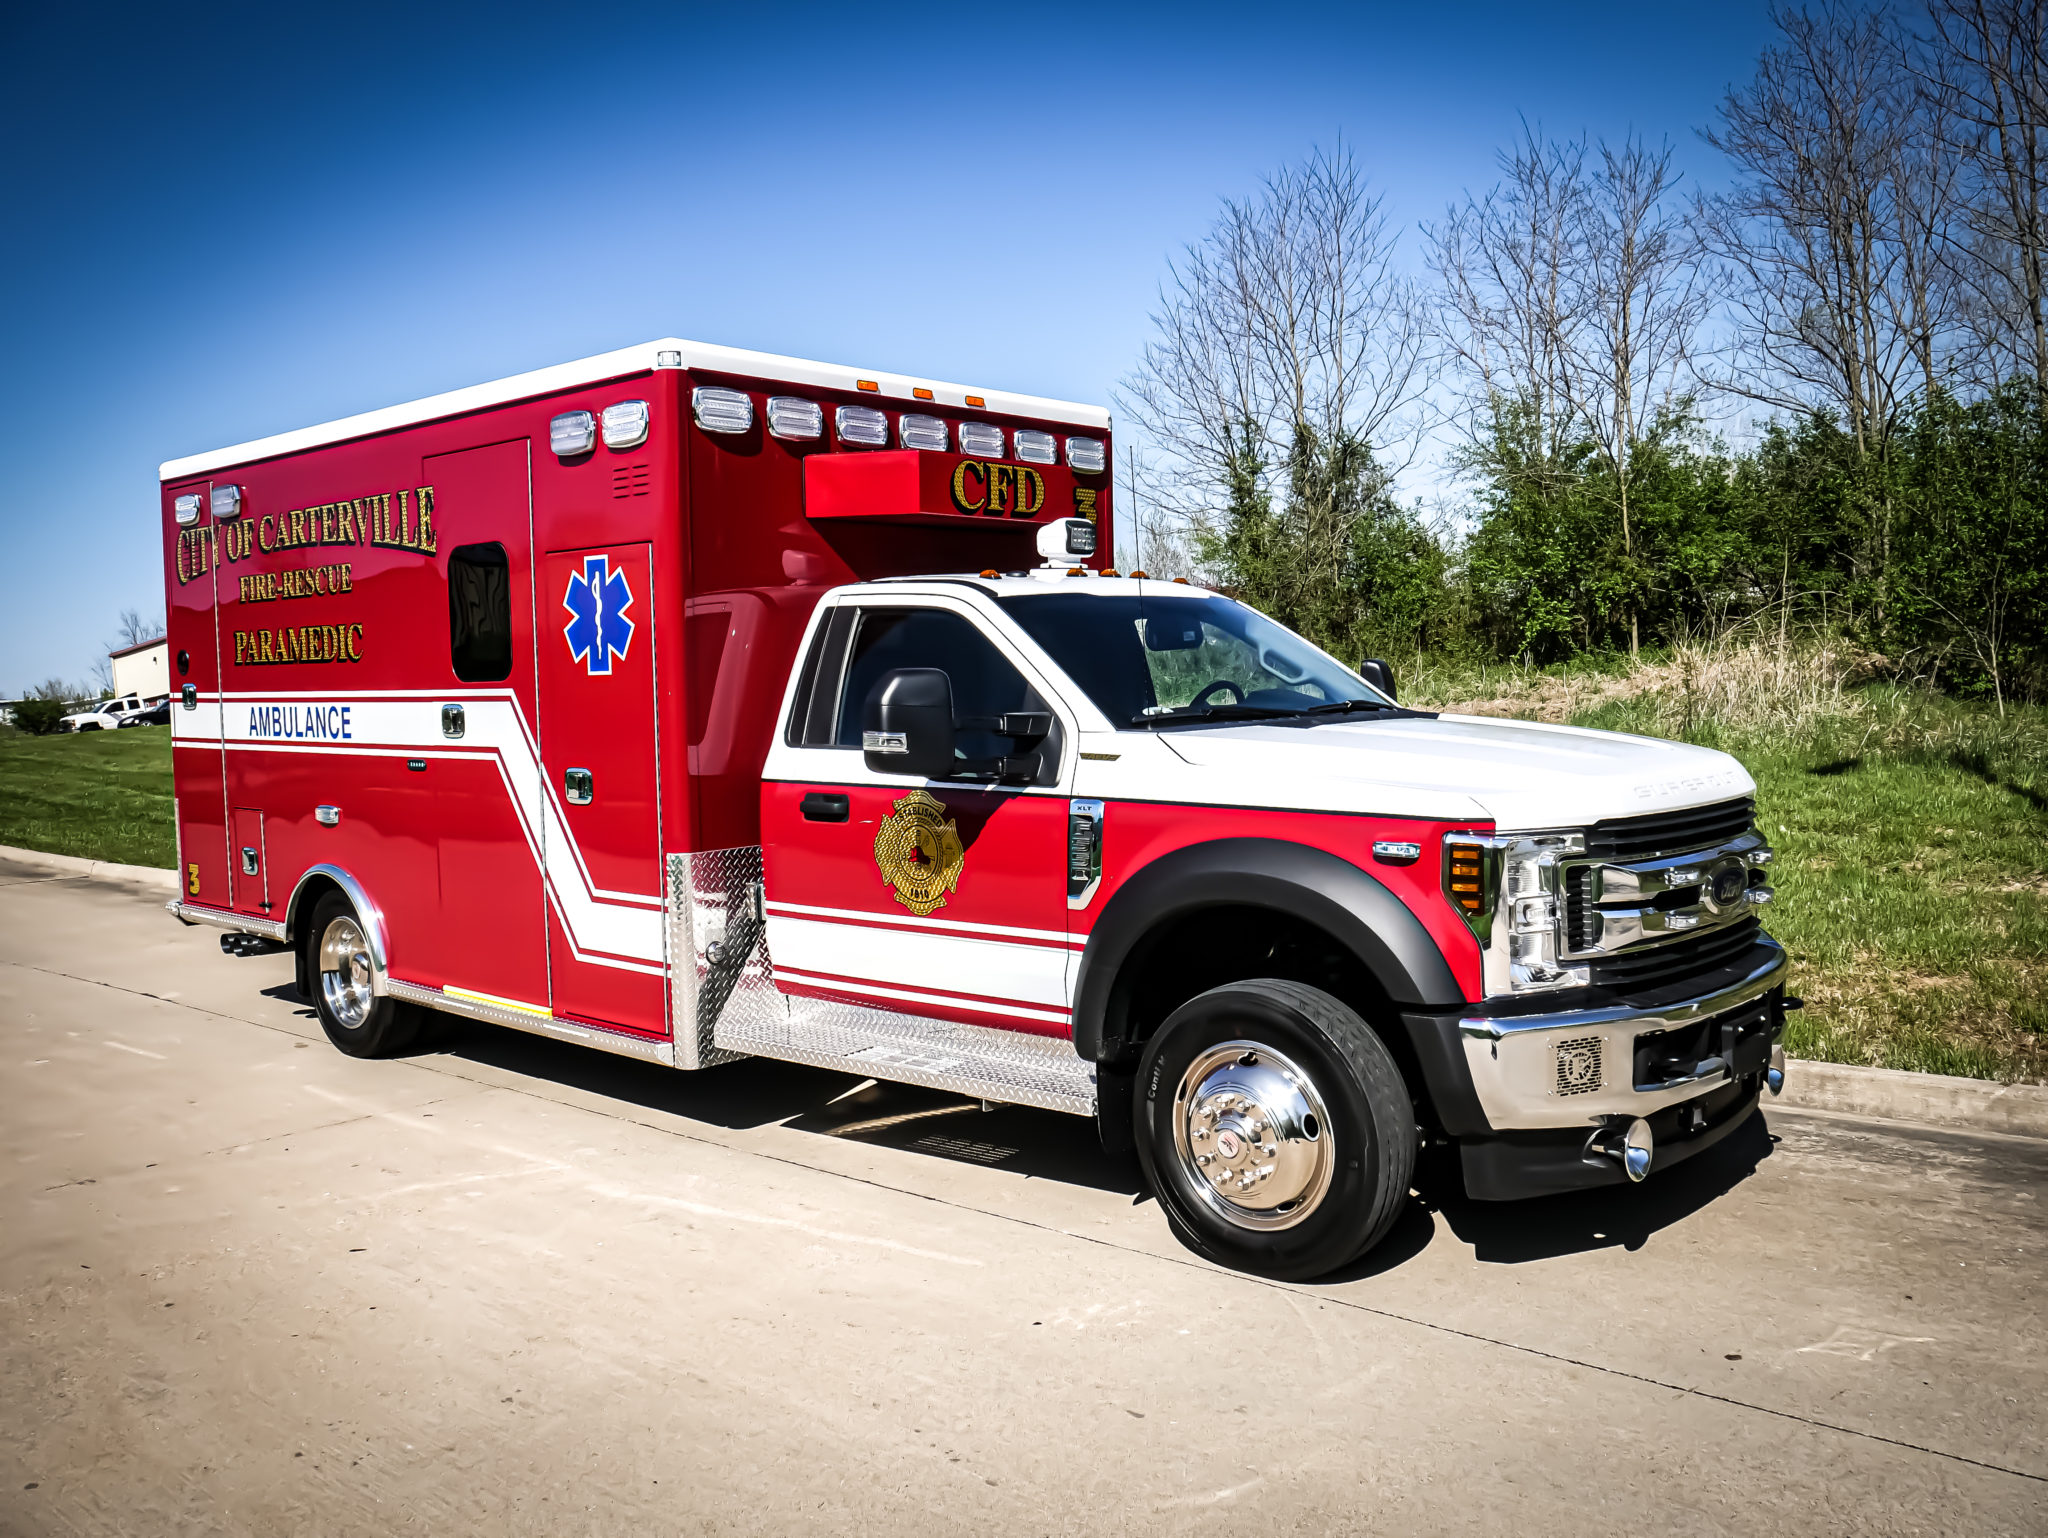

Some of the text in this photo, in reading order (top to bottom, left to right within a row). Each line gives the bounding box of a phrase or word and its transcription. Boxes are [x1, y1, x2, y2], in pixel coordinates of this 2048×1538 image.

[951, 459, 1045, 519] CFD
[176, 485, 438, 586] CITY OF CARTERVILLE
[238, 563, 353, 603] FIRE-RESCUE
[234, 623, 364, 665] PARAMEDIC
[249, 705, 352, 739] AMBULANCE
[894, 806, 943, 828] ESTABLISHED
[188, 863, 200, 897] 3
